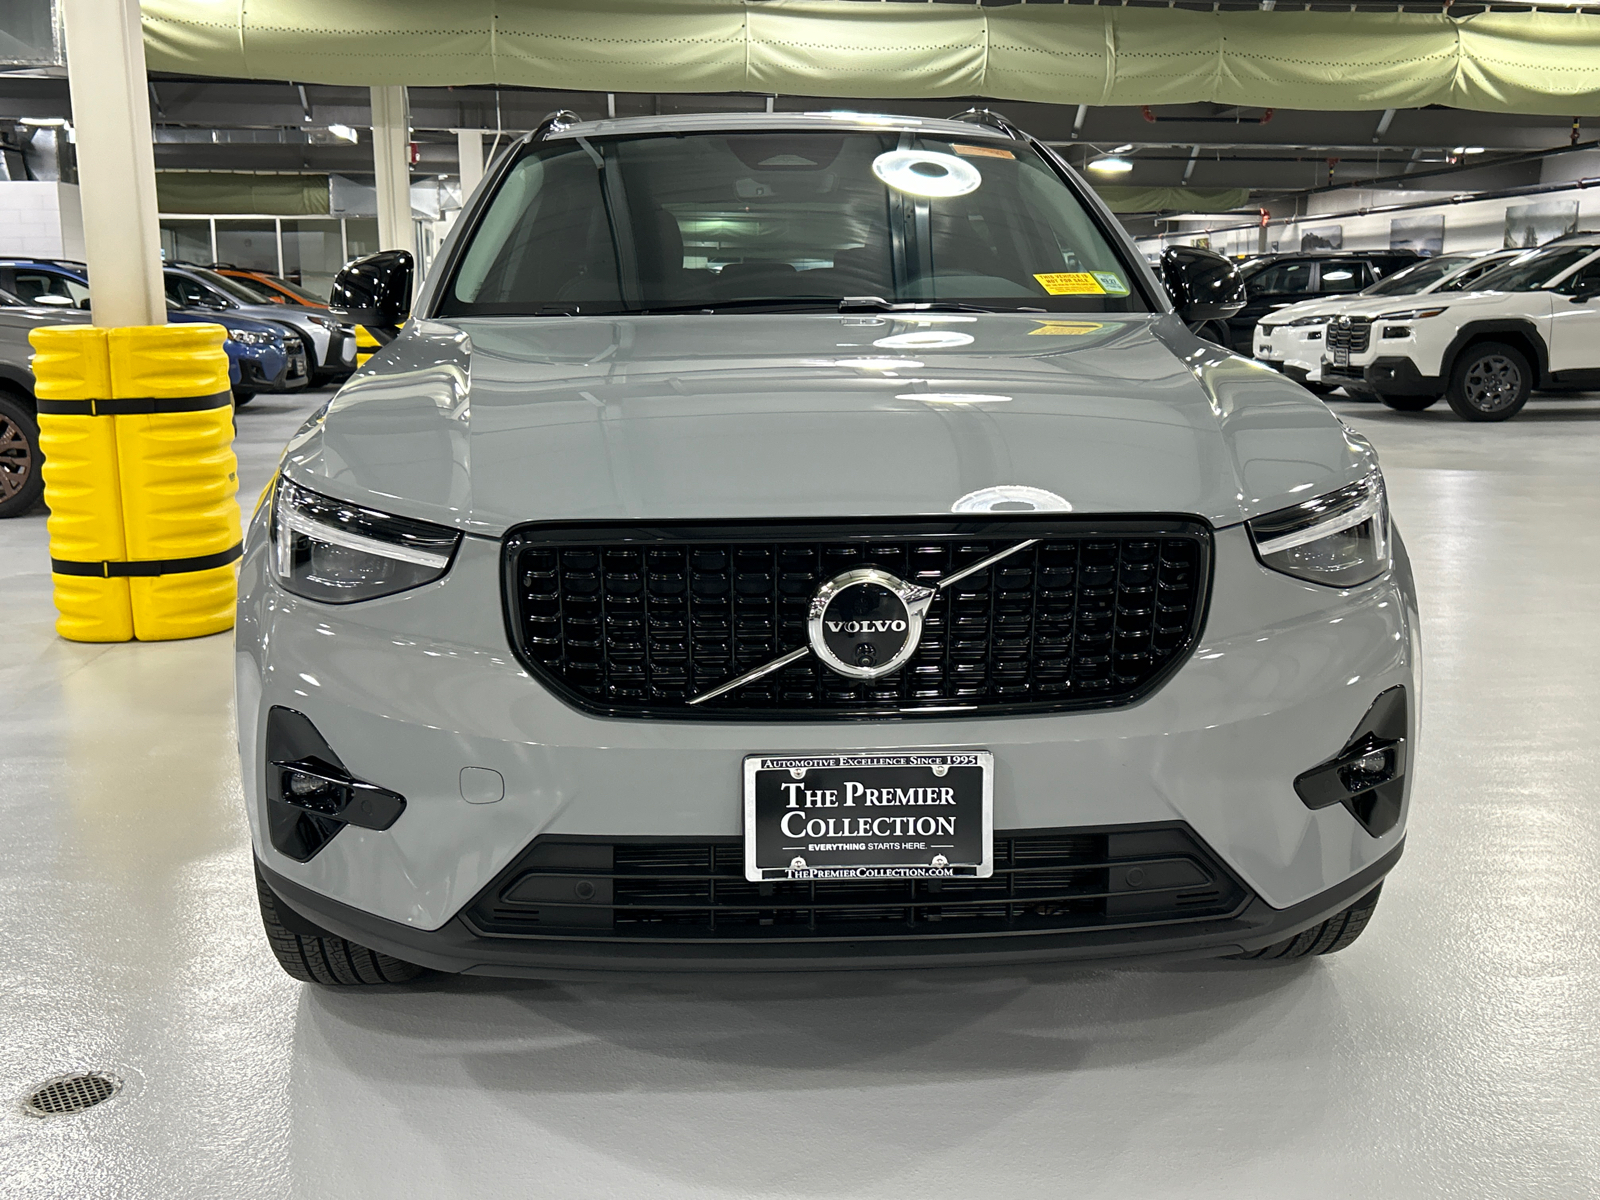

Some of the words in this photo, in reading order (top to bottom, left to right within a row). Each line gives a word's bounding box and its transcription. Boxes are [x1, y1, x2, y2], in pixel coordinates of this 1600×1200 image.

[825, 620, 907, 633] VOLVO
[763, 759, 836, 769] AUTOMOTIVE
[839, 757, 907, 767] EXCELLENCE
[909, 756, 943, 766] SINCE
[946, 755, 977, 766] 1995
[780, 782, 839, 809] THE
[843, 781, 957, 808] PREMIER
[780, 810, 957, 838] COLLECTION
[808, 843, 866, 851] EVERYTHING
[867, 842, 900, 850] STARTS
[902, 842, 928, 850] HERE.
